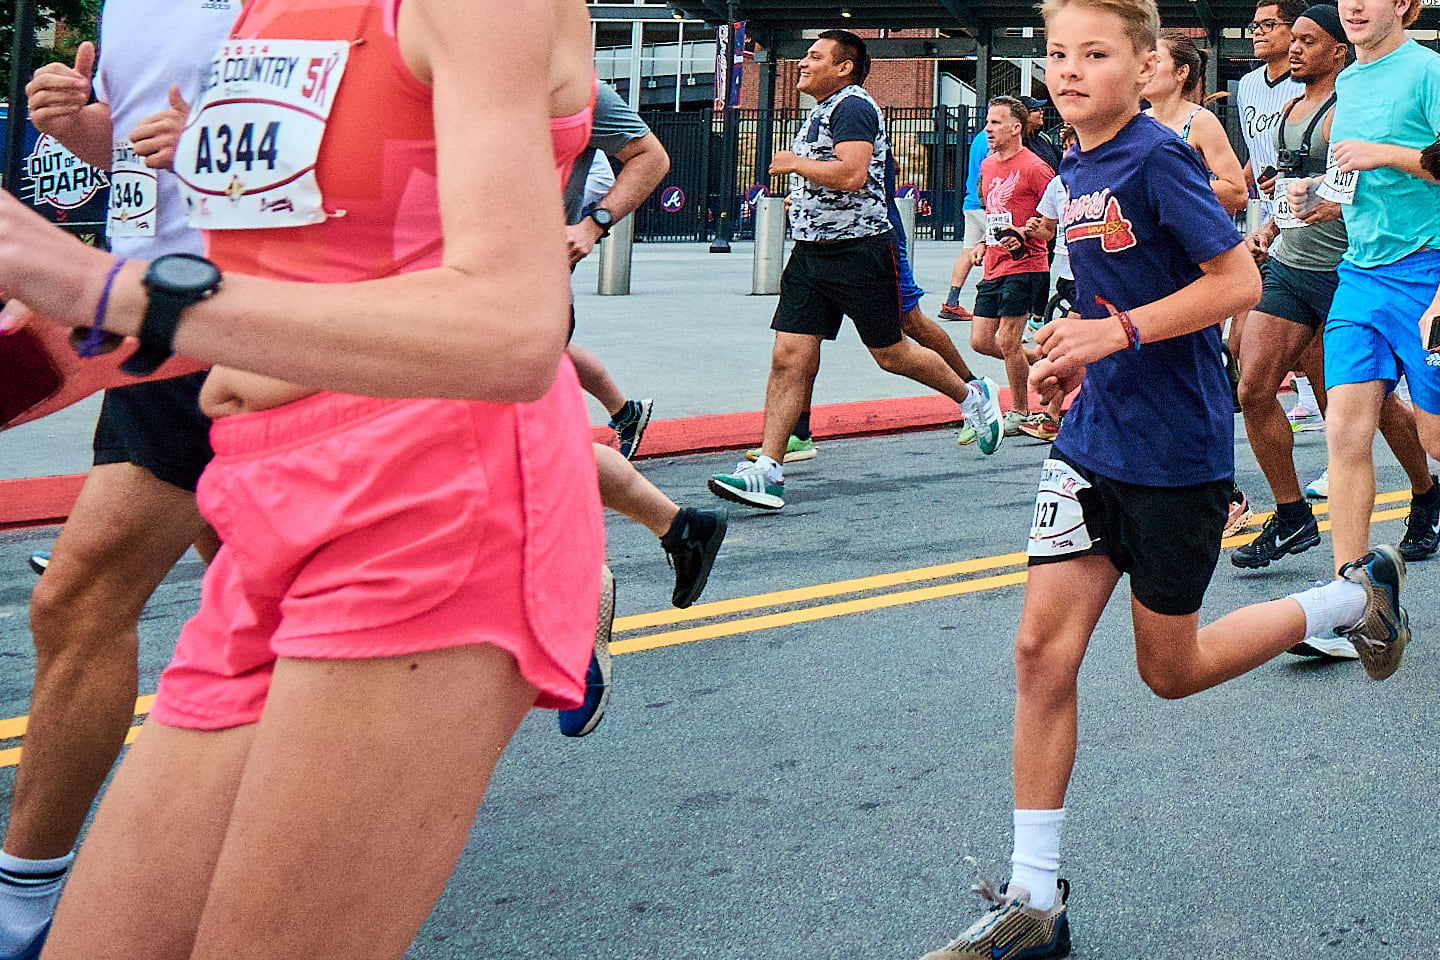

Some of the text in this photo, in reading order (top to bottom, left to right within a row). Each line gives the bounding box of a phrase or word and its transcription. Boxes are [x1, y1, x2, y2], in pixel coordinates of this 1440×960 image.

[223, 56, 300, 89] COUNTRY
[301, 51, 339, 108] 5K
[31, 151, 75, 176] OUT OF
[195, 121, 282, 175] A344
[39, 165, 105, 199] PARK
[112, 182, 143, 209] 346
